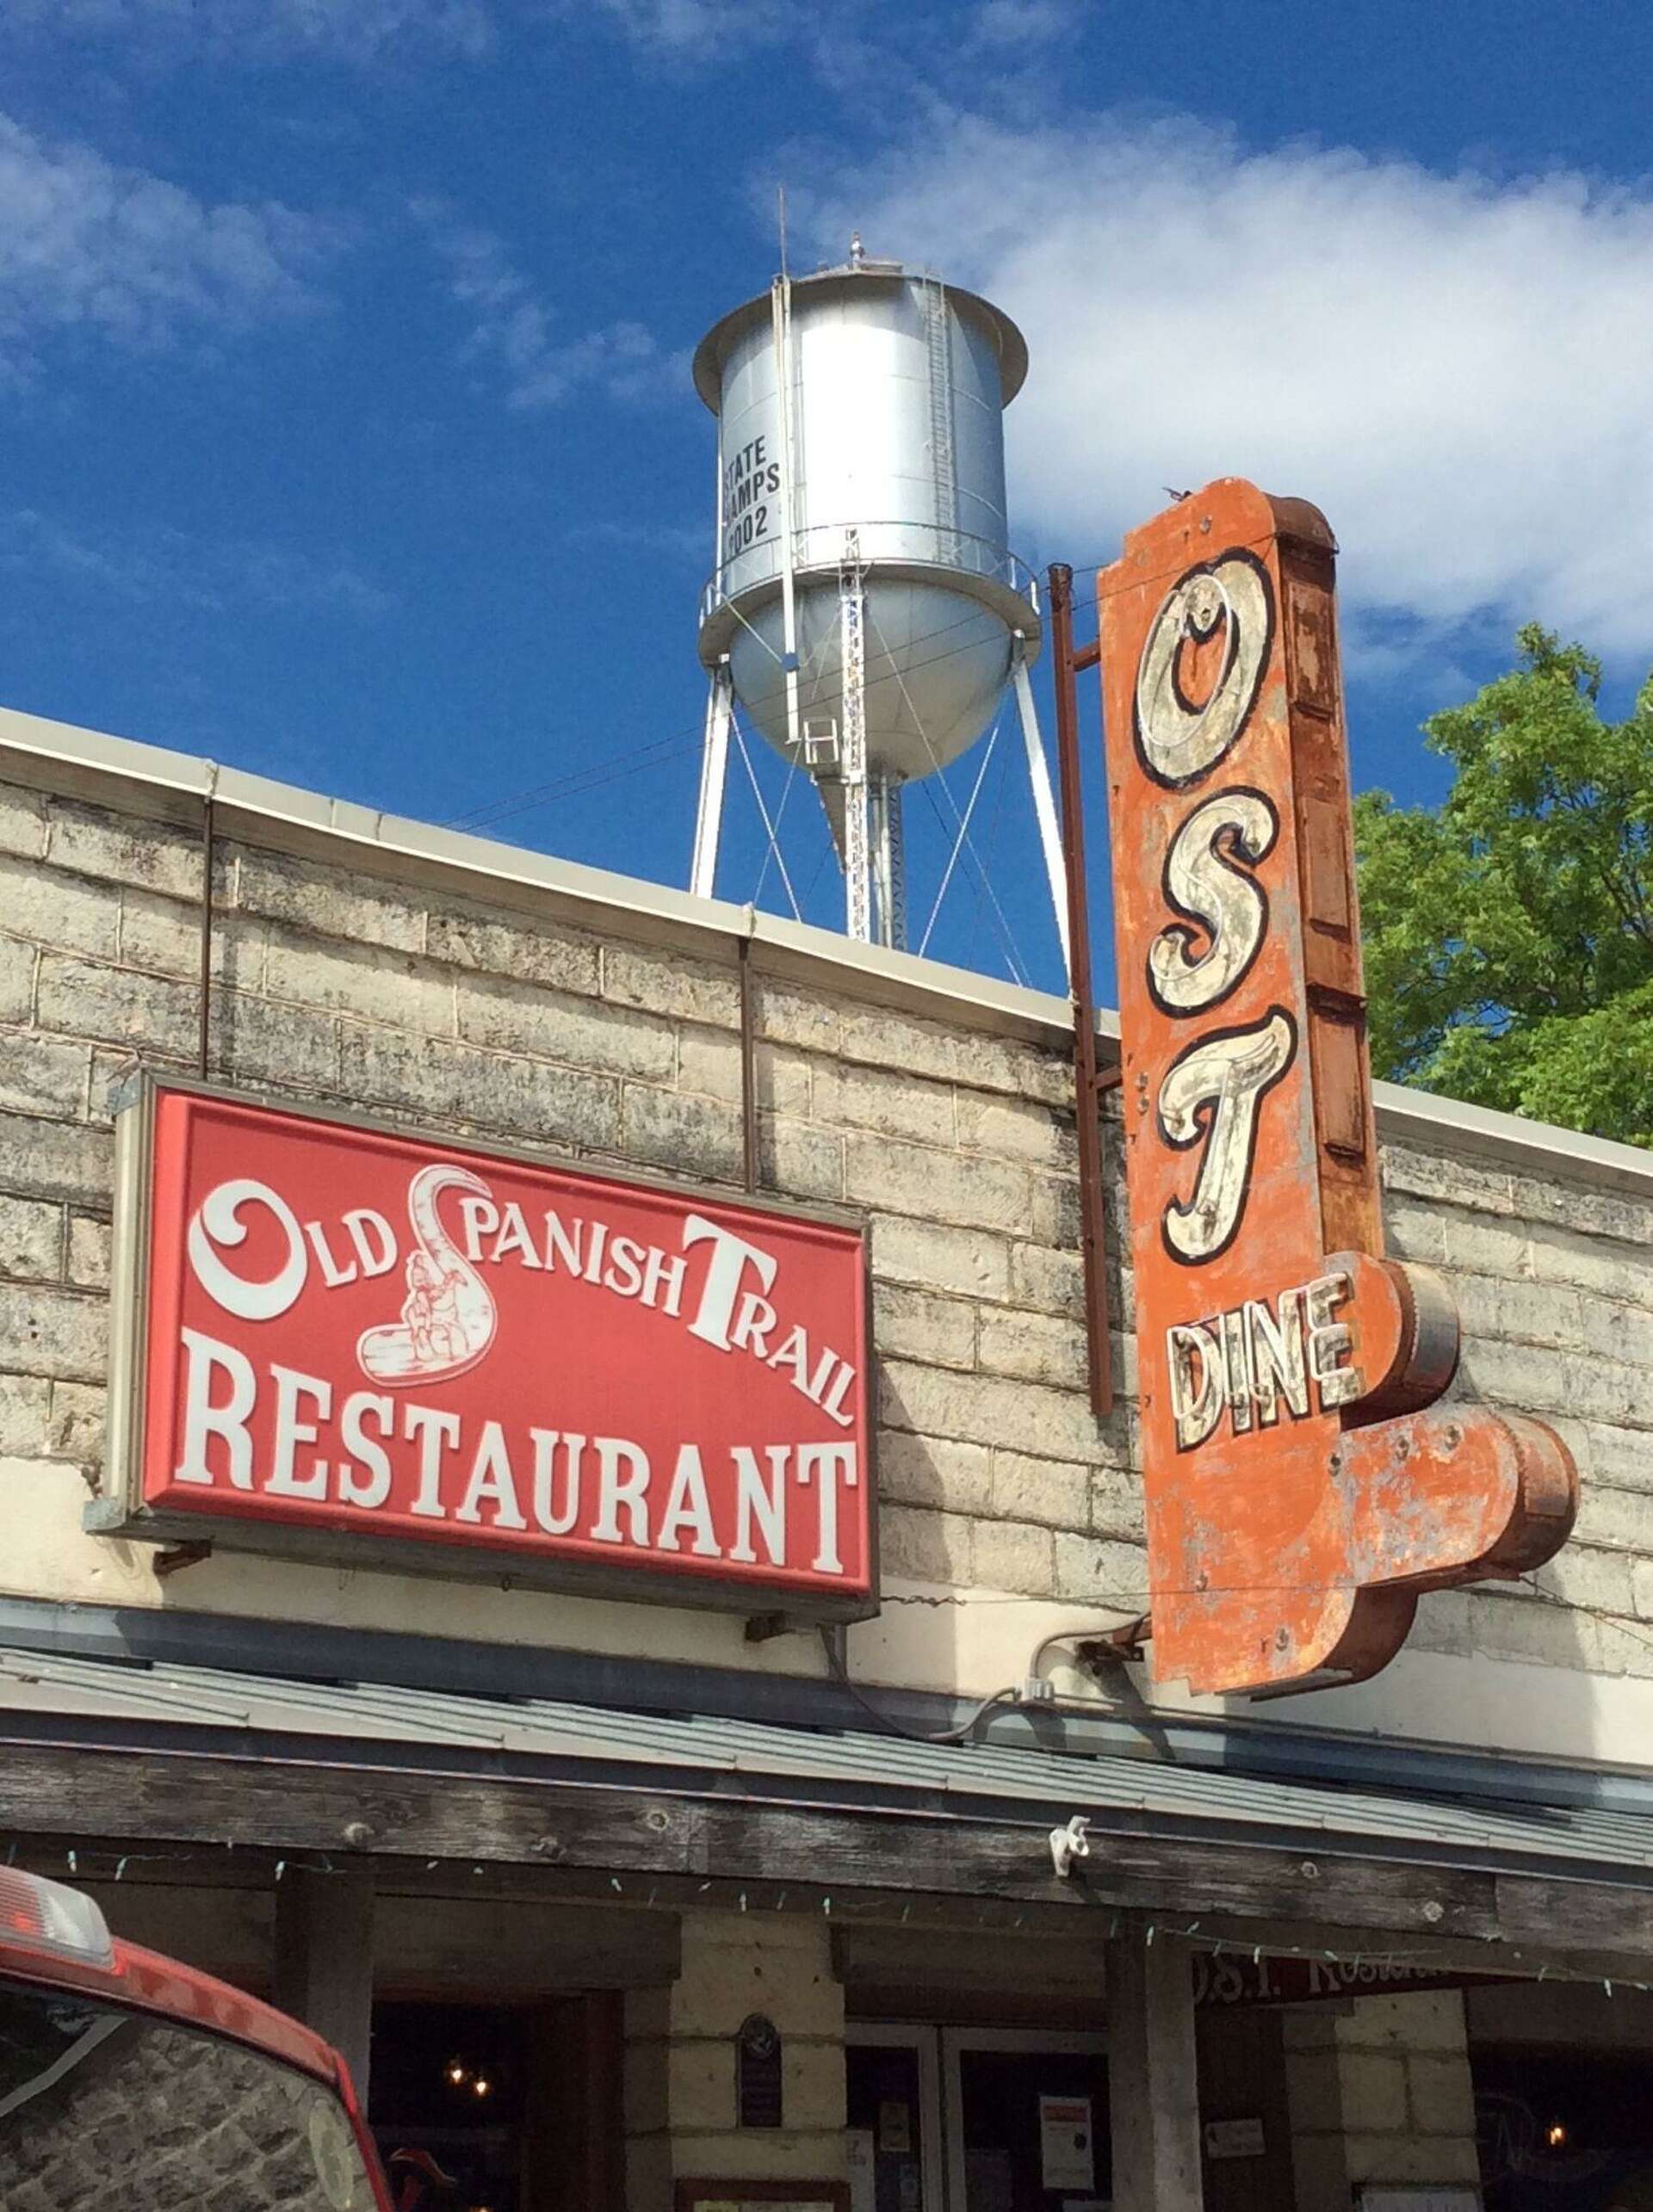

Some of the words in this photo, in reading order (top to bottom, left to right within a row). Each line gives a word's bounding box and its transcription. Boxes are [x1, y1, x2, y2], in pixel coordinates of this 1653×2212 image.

[1133, 546, 1297, 1266] OST
[189, 1179, 399, 1320] OLD
[356, 1164, 687, 1387] SPANISH
[682, 1214, 856, 1427] TRAIL
[1166, 1271, 1365, 1453] DINE
[175, 1328, 857, 1575] RESTAURANT
